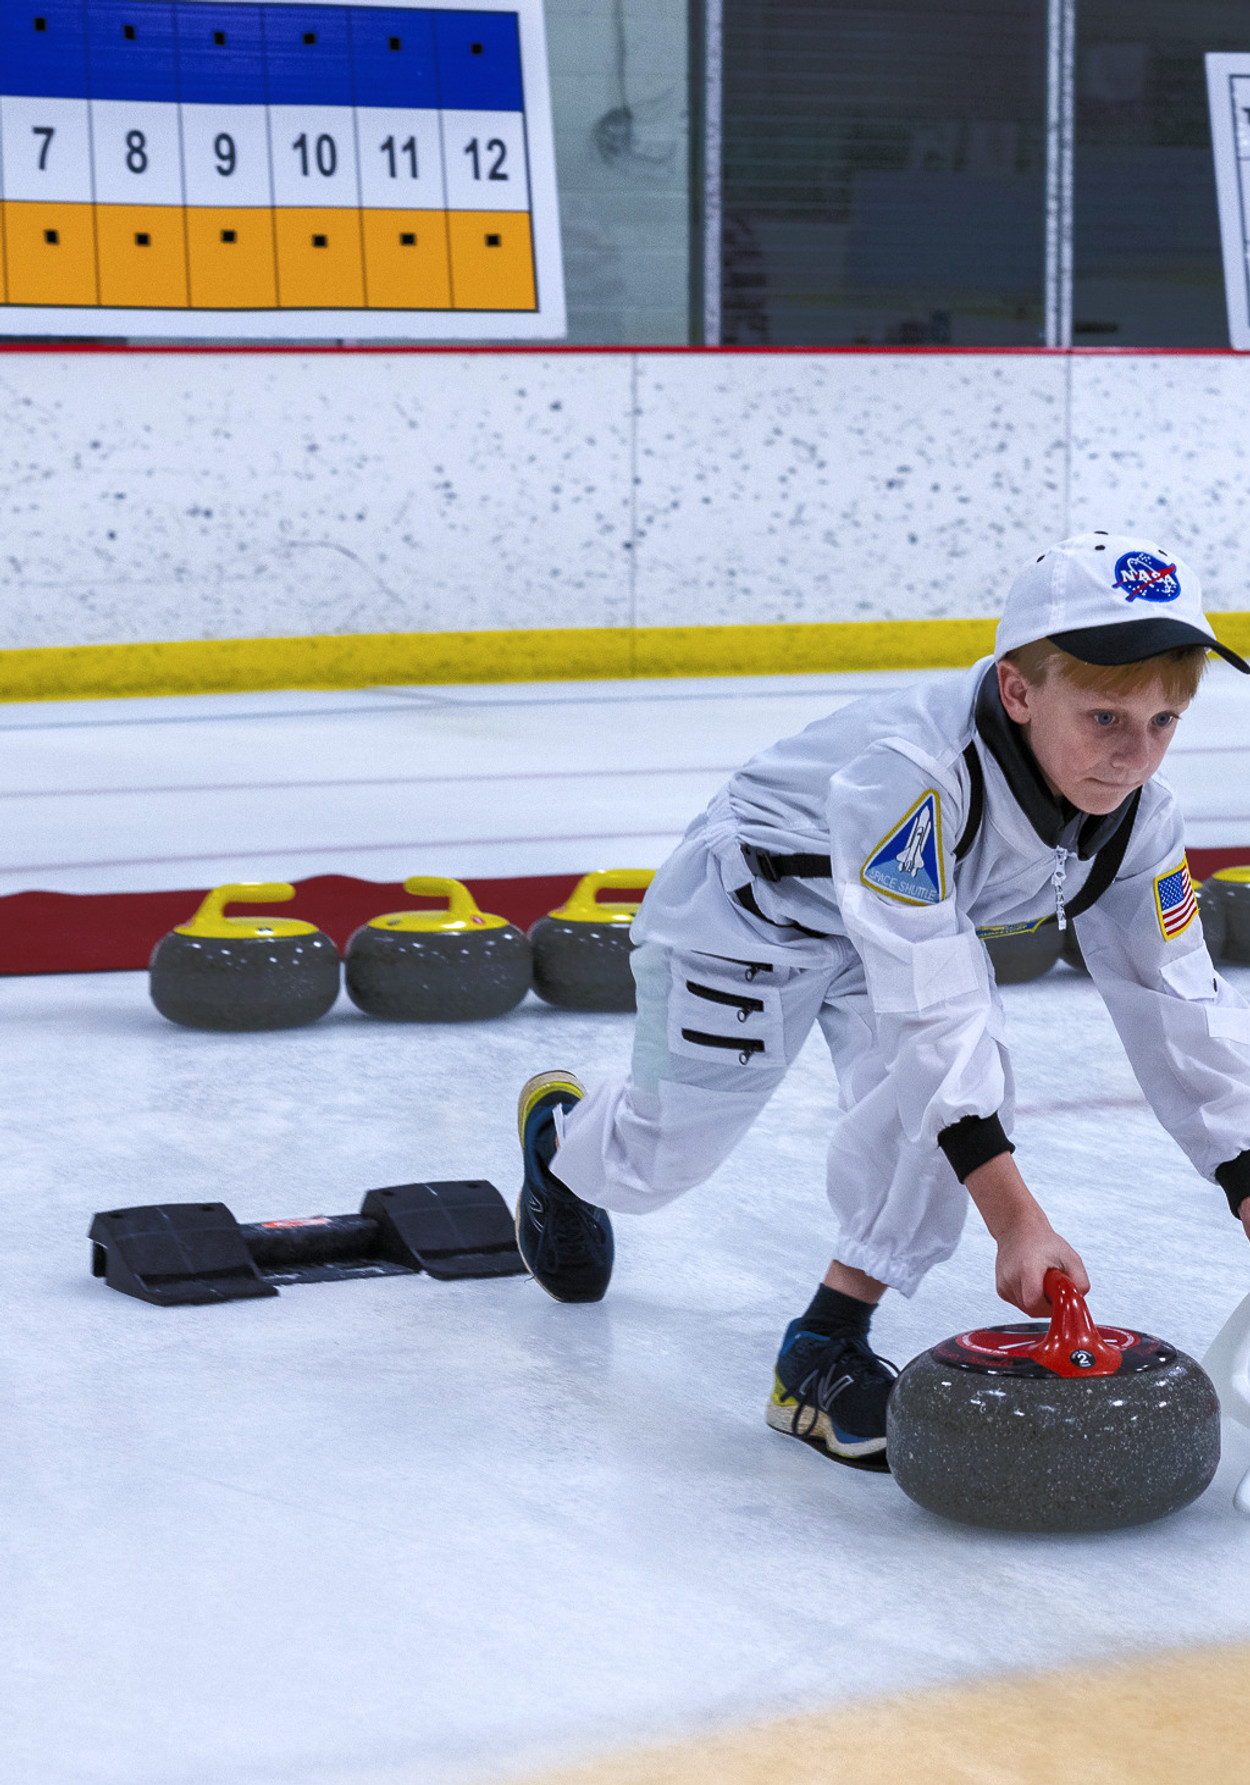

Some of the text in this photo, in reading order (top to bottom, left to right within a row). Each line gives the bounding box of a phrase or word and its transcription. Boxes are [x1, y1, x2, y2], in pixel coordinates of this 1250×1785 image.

[32, 126, 509, 181] 7 8 9 10 11 12
[1120, 568, 1178, 588] NASA
[868, 870, 938, 901] SPACE SHUTTLE
[1077, 1353, 1089, 1364] 2
